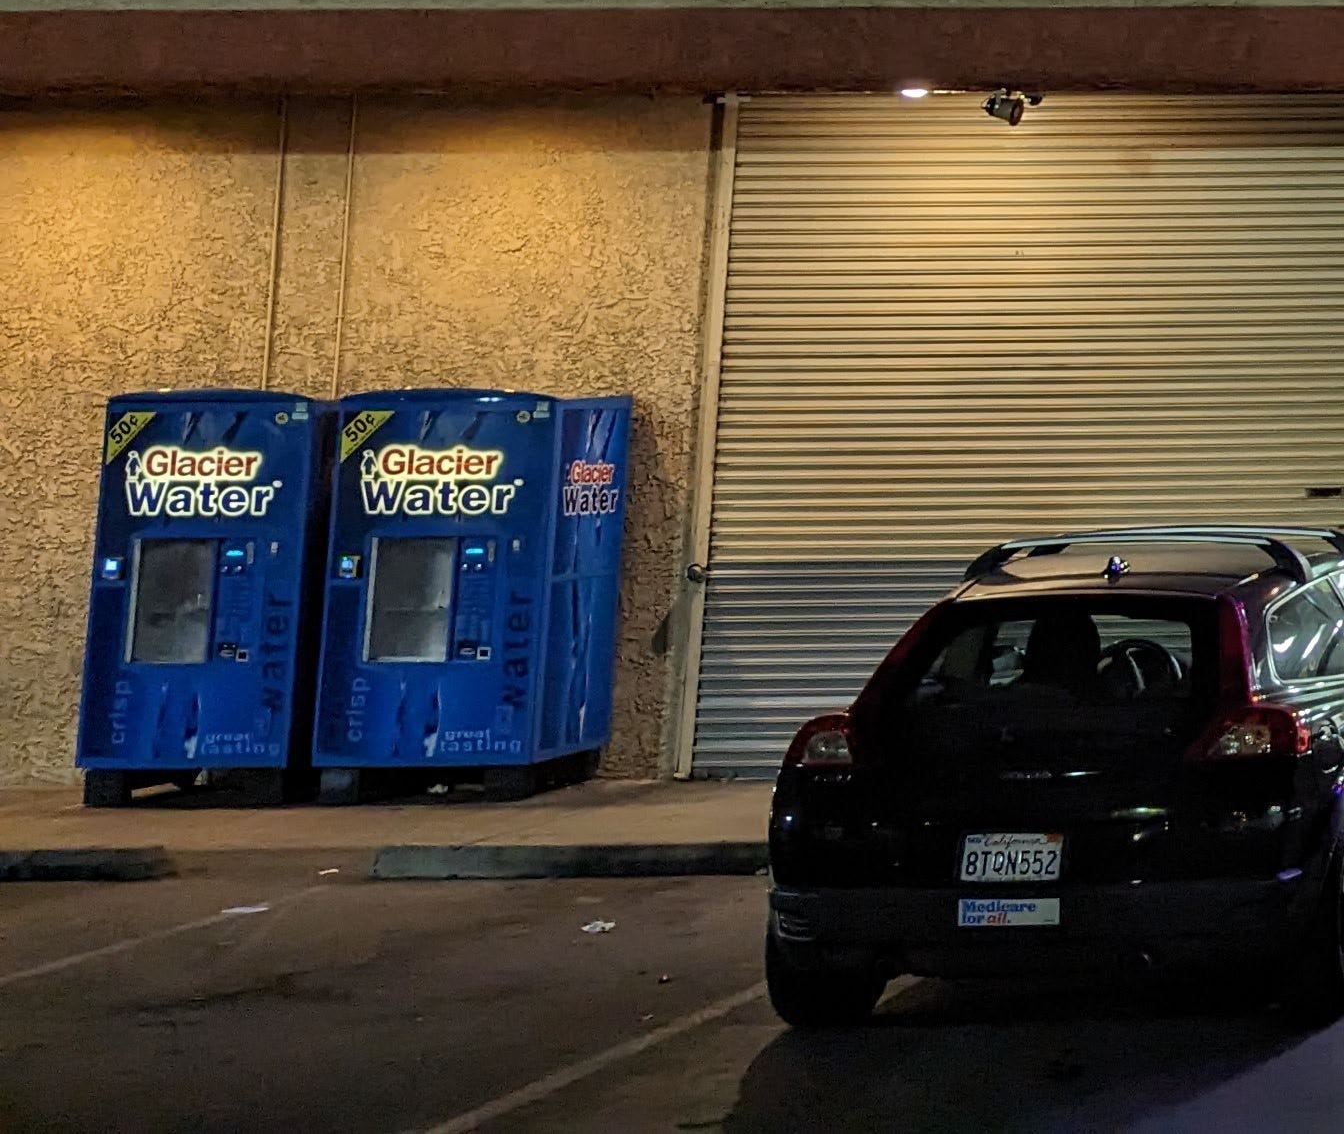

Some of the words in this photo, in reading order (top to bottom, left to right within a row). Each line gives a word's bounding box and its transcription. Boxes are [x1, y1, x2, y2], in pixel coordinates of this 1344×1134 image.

[110, 414, 138, 444] 50¢
[345, 413, 376, 443] 50¢
[146, 449, 258, 477] Glacier
[382, 449, 499, 476] Glacier
[570, 460, 615, 486] Glacier
[126, 480, 276, 516] Water
[360, 478, 516, 515] Water
[562, 485, 619, 516] Water
[965, 850, 1058, 876] 8TQN552
[961, 899, 1037, 913] Medicare
[961, 913, 985, 924] for
